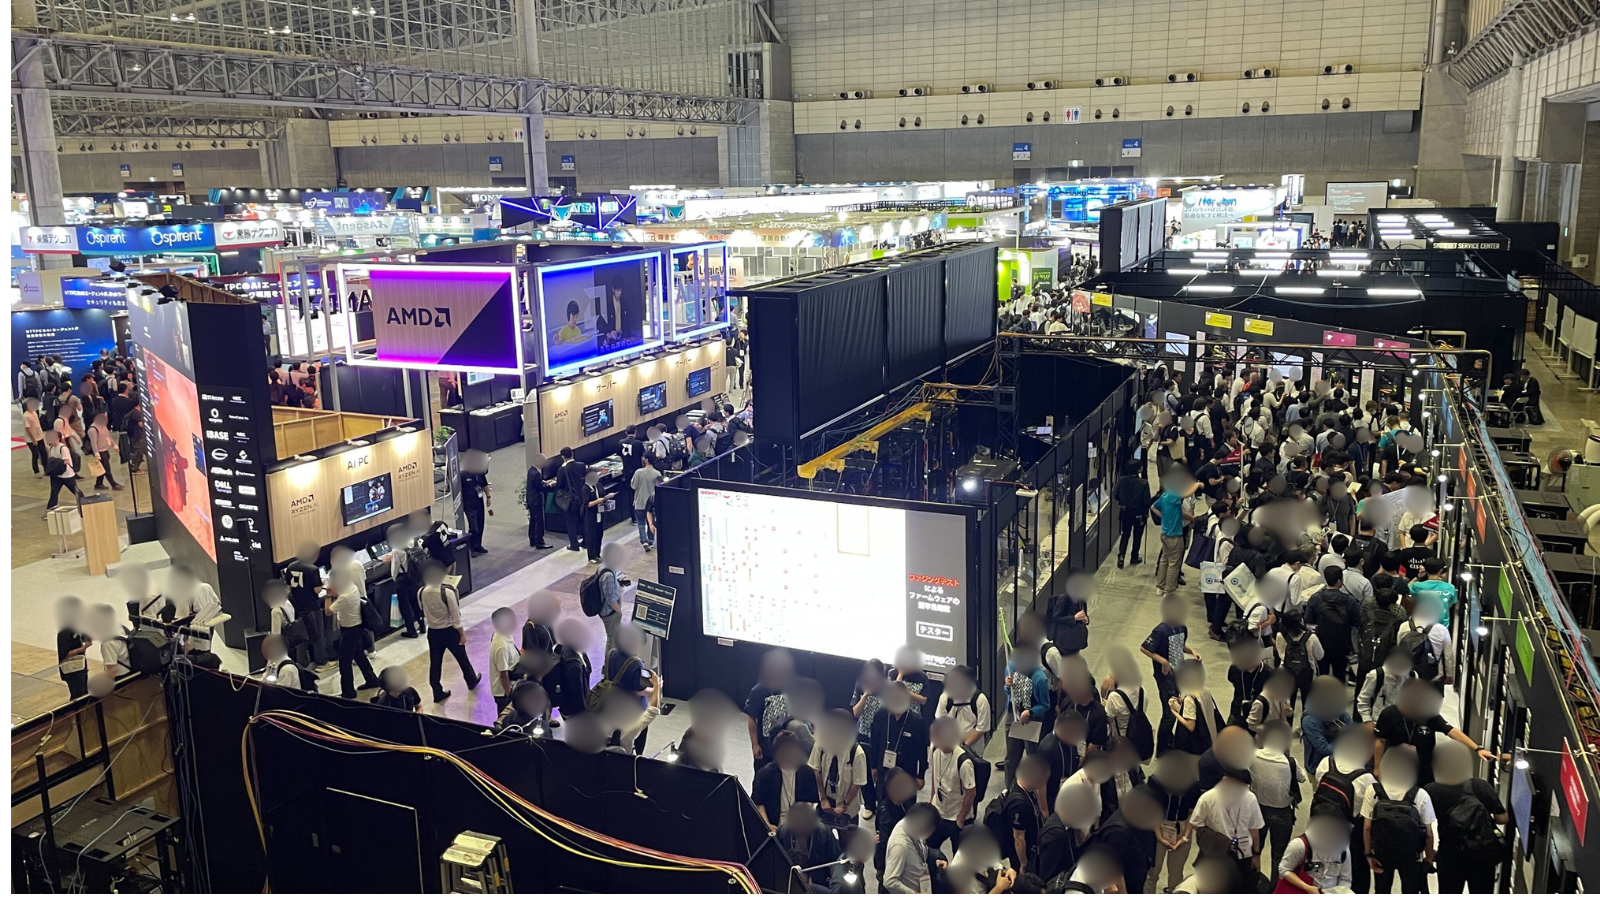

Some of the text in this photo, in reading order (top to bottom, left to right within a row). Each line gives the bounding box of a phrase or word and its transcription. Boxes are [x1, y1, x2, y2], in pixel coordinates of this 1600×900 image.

[478, 194, 502, 202] ONY
[570, 202, 595, 212] ATEN
[699, 265, 737, 275] LgicVin
[387, 307, 433, 325] AMD
[347, 455, 369, 470] AI PC
[398, 463, 413, 473] AMD
[291, 497, 308, 508] AMD
[909, 574, 960, 587] ファジングテスト
[924, 585, 944, 594] による
[909, 592, 960, 605] ファームウェアの
[919, 625, 949, 636] テスター
